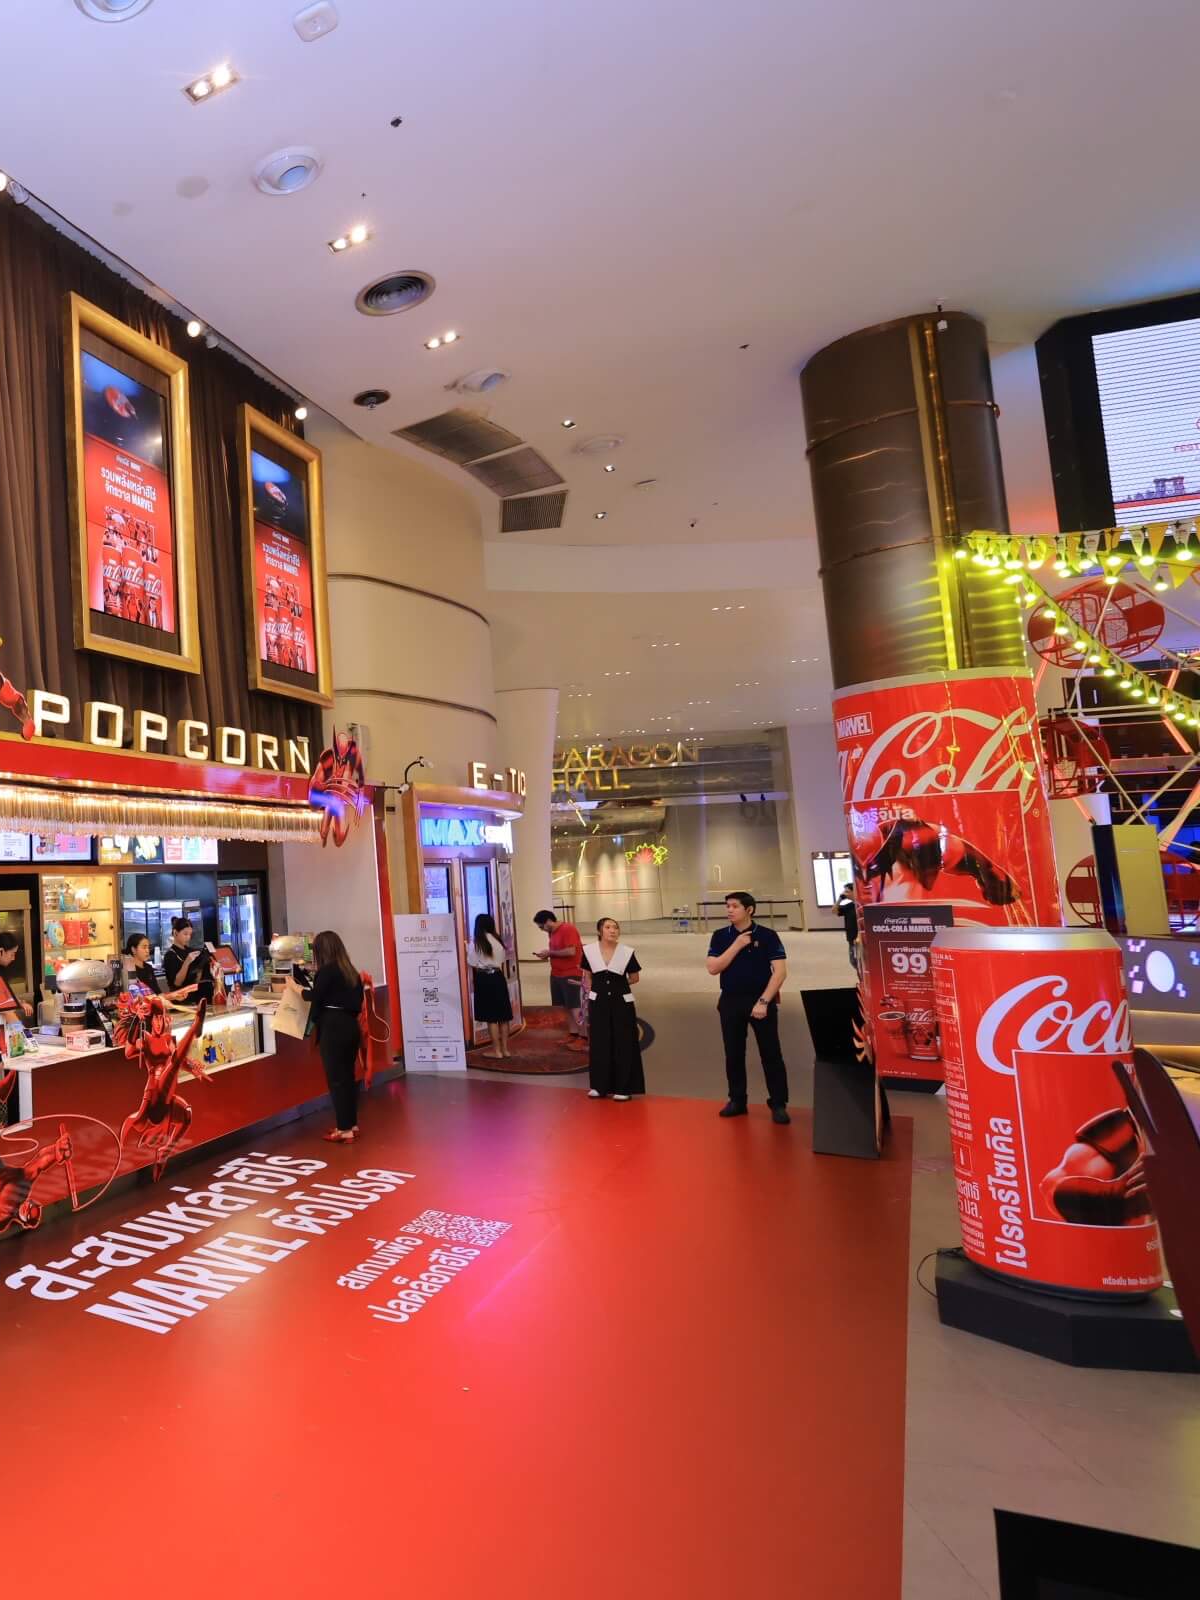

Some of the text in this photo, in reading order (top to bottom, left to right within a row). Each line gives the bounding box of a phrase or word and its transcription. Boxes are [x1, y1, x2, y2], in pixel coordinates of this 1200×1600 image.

[28, 688, 312, 775] POPCORN
[552, 768, 631, 792] HALL
[872, 925, 908, 933] COCA-COLA
[909, 925, 933, 933] MARVEL
[891, 952, 928, 975] 99
[5, 1150, 328, 1302] สะสมเหล่าฮีโร่
[986, 1116, 1029, 1269] โปรดรีไซเคิล
[84, 1167, 417, 1334] MARVEL ตัวโปรด
[336, 1235, 425, 1291] สแกนเพื่อ
